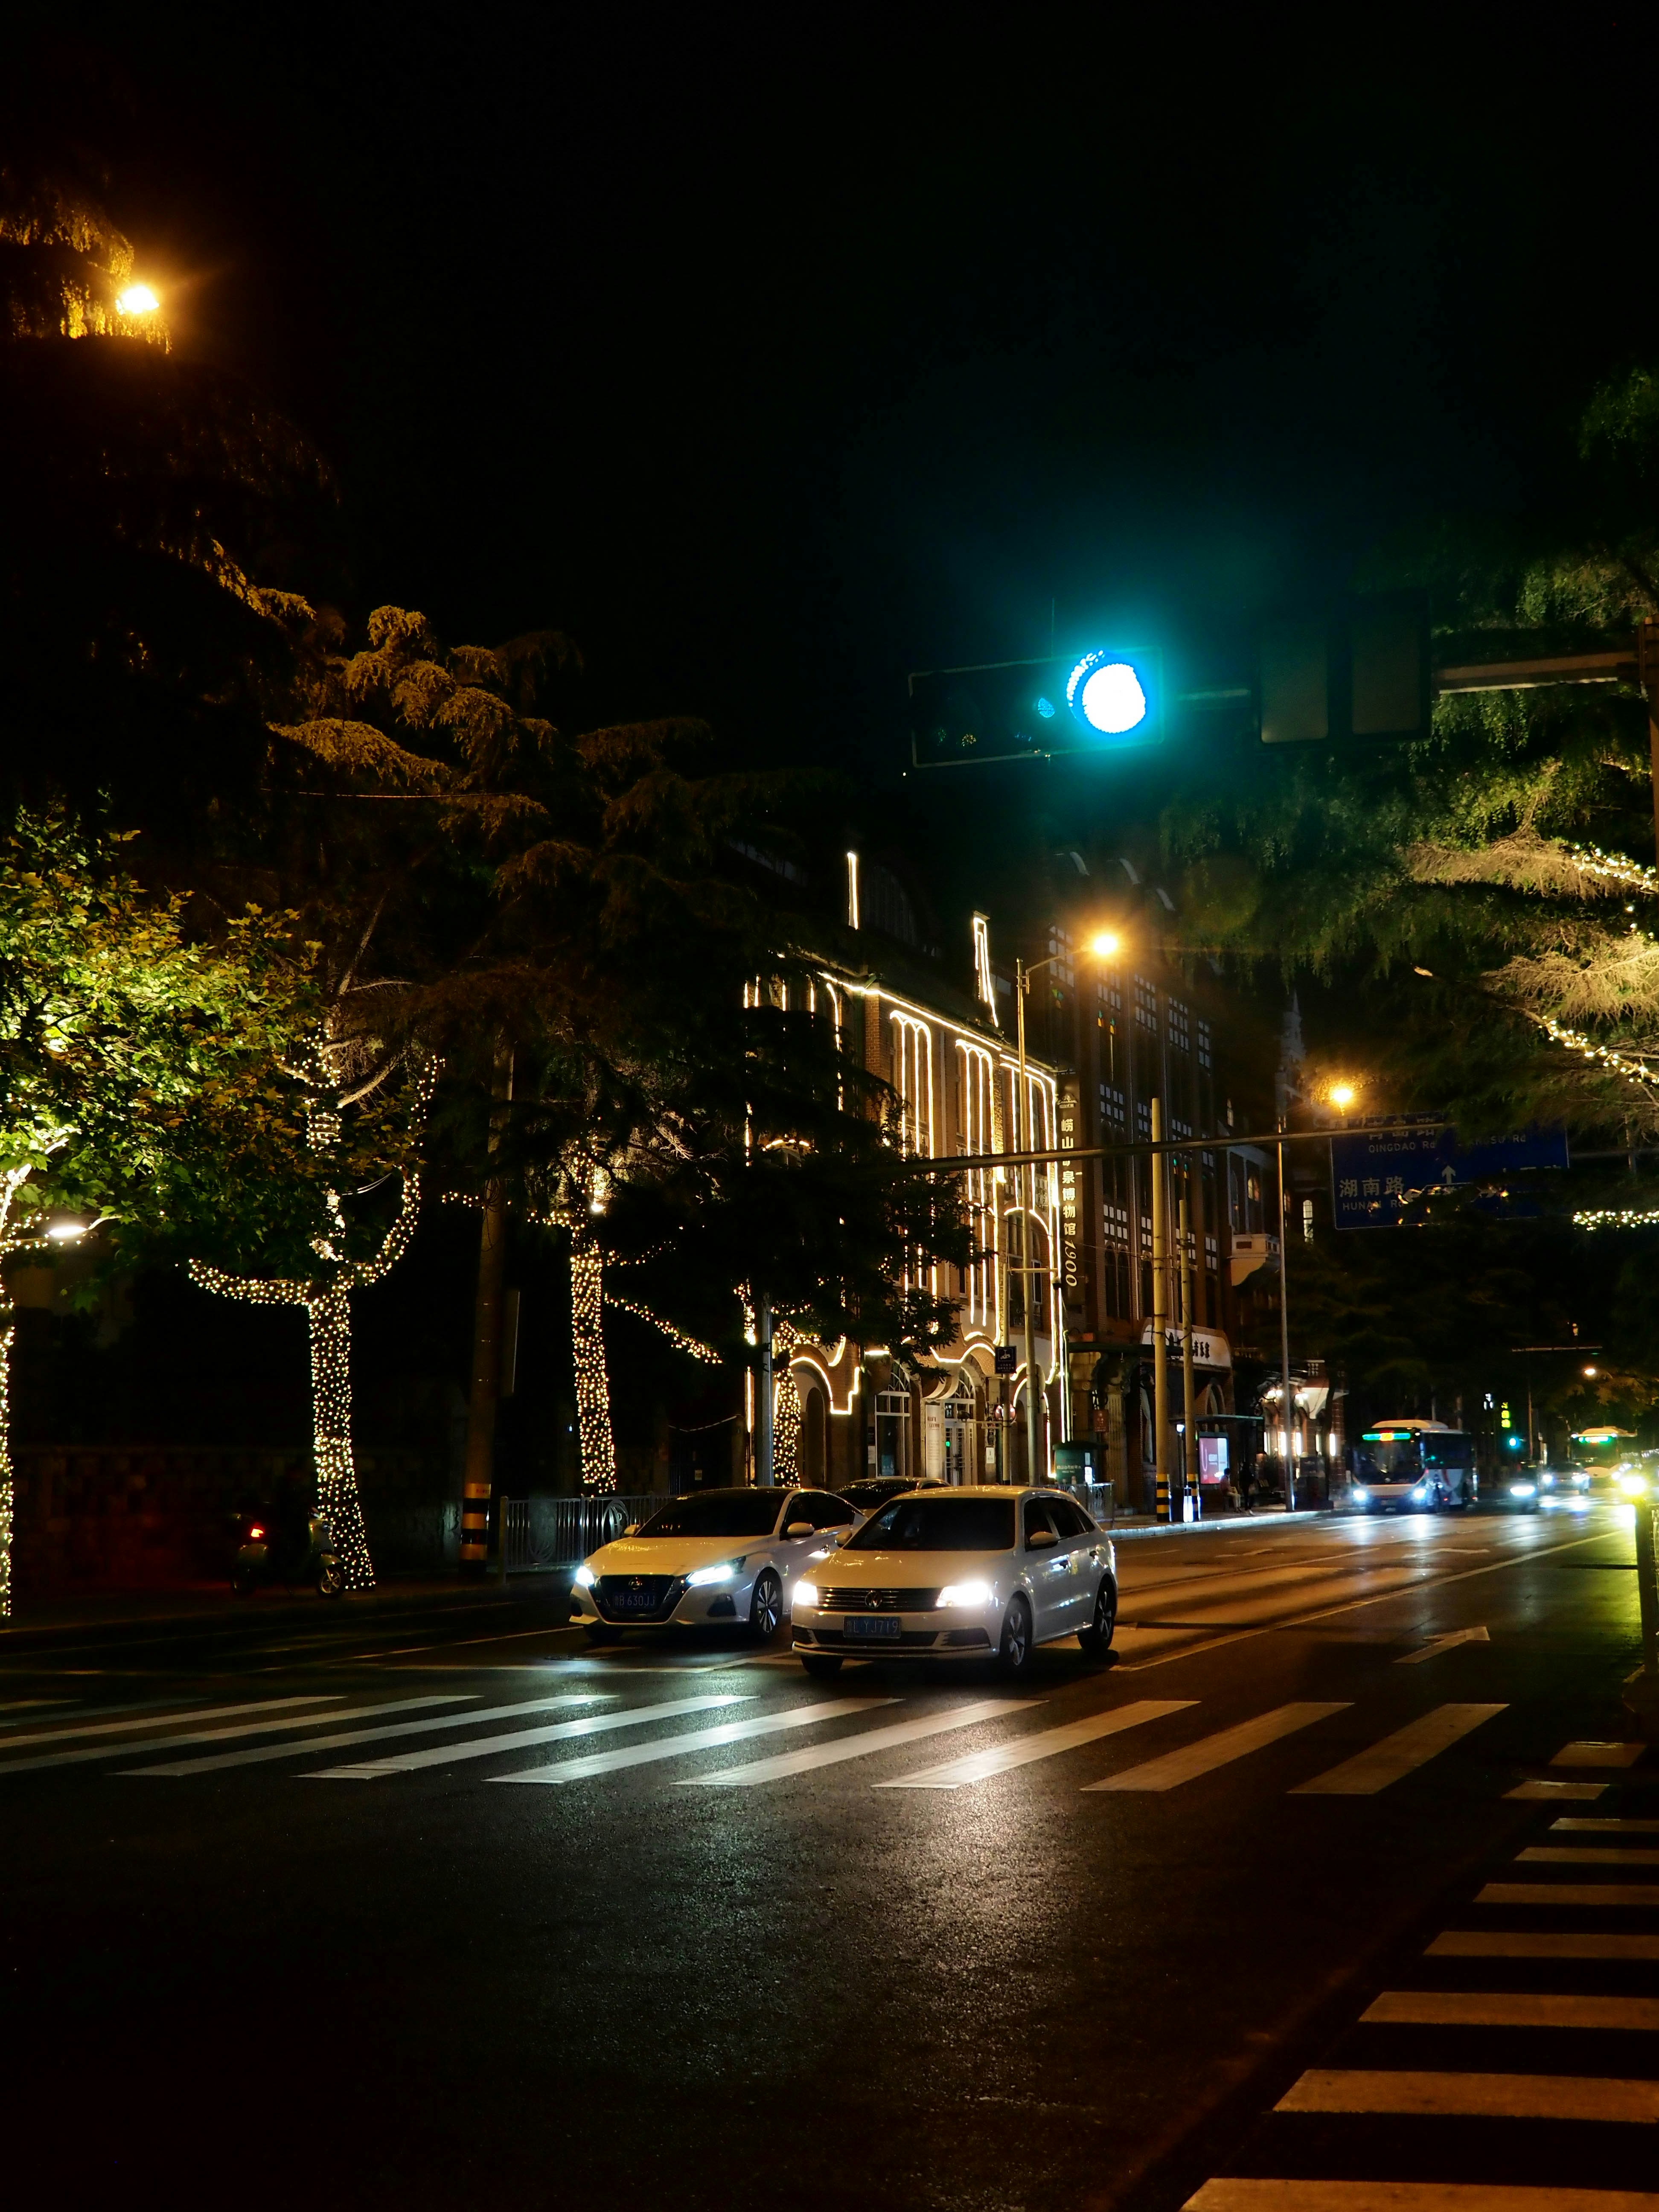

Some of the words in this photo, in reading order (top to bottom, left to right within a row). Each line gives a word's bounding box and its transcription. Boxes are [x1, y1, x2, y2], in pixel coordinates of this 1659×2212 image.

[1368, 1141, 1416, 1153] QINGDAO
[1422, 1141, 1436, 1149] Rd
[1339, 1176, 1404, 1197] 湖南路
[1064, 1240, 1077, 1286] 1900
